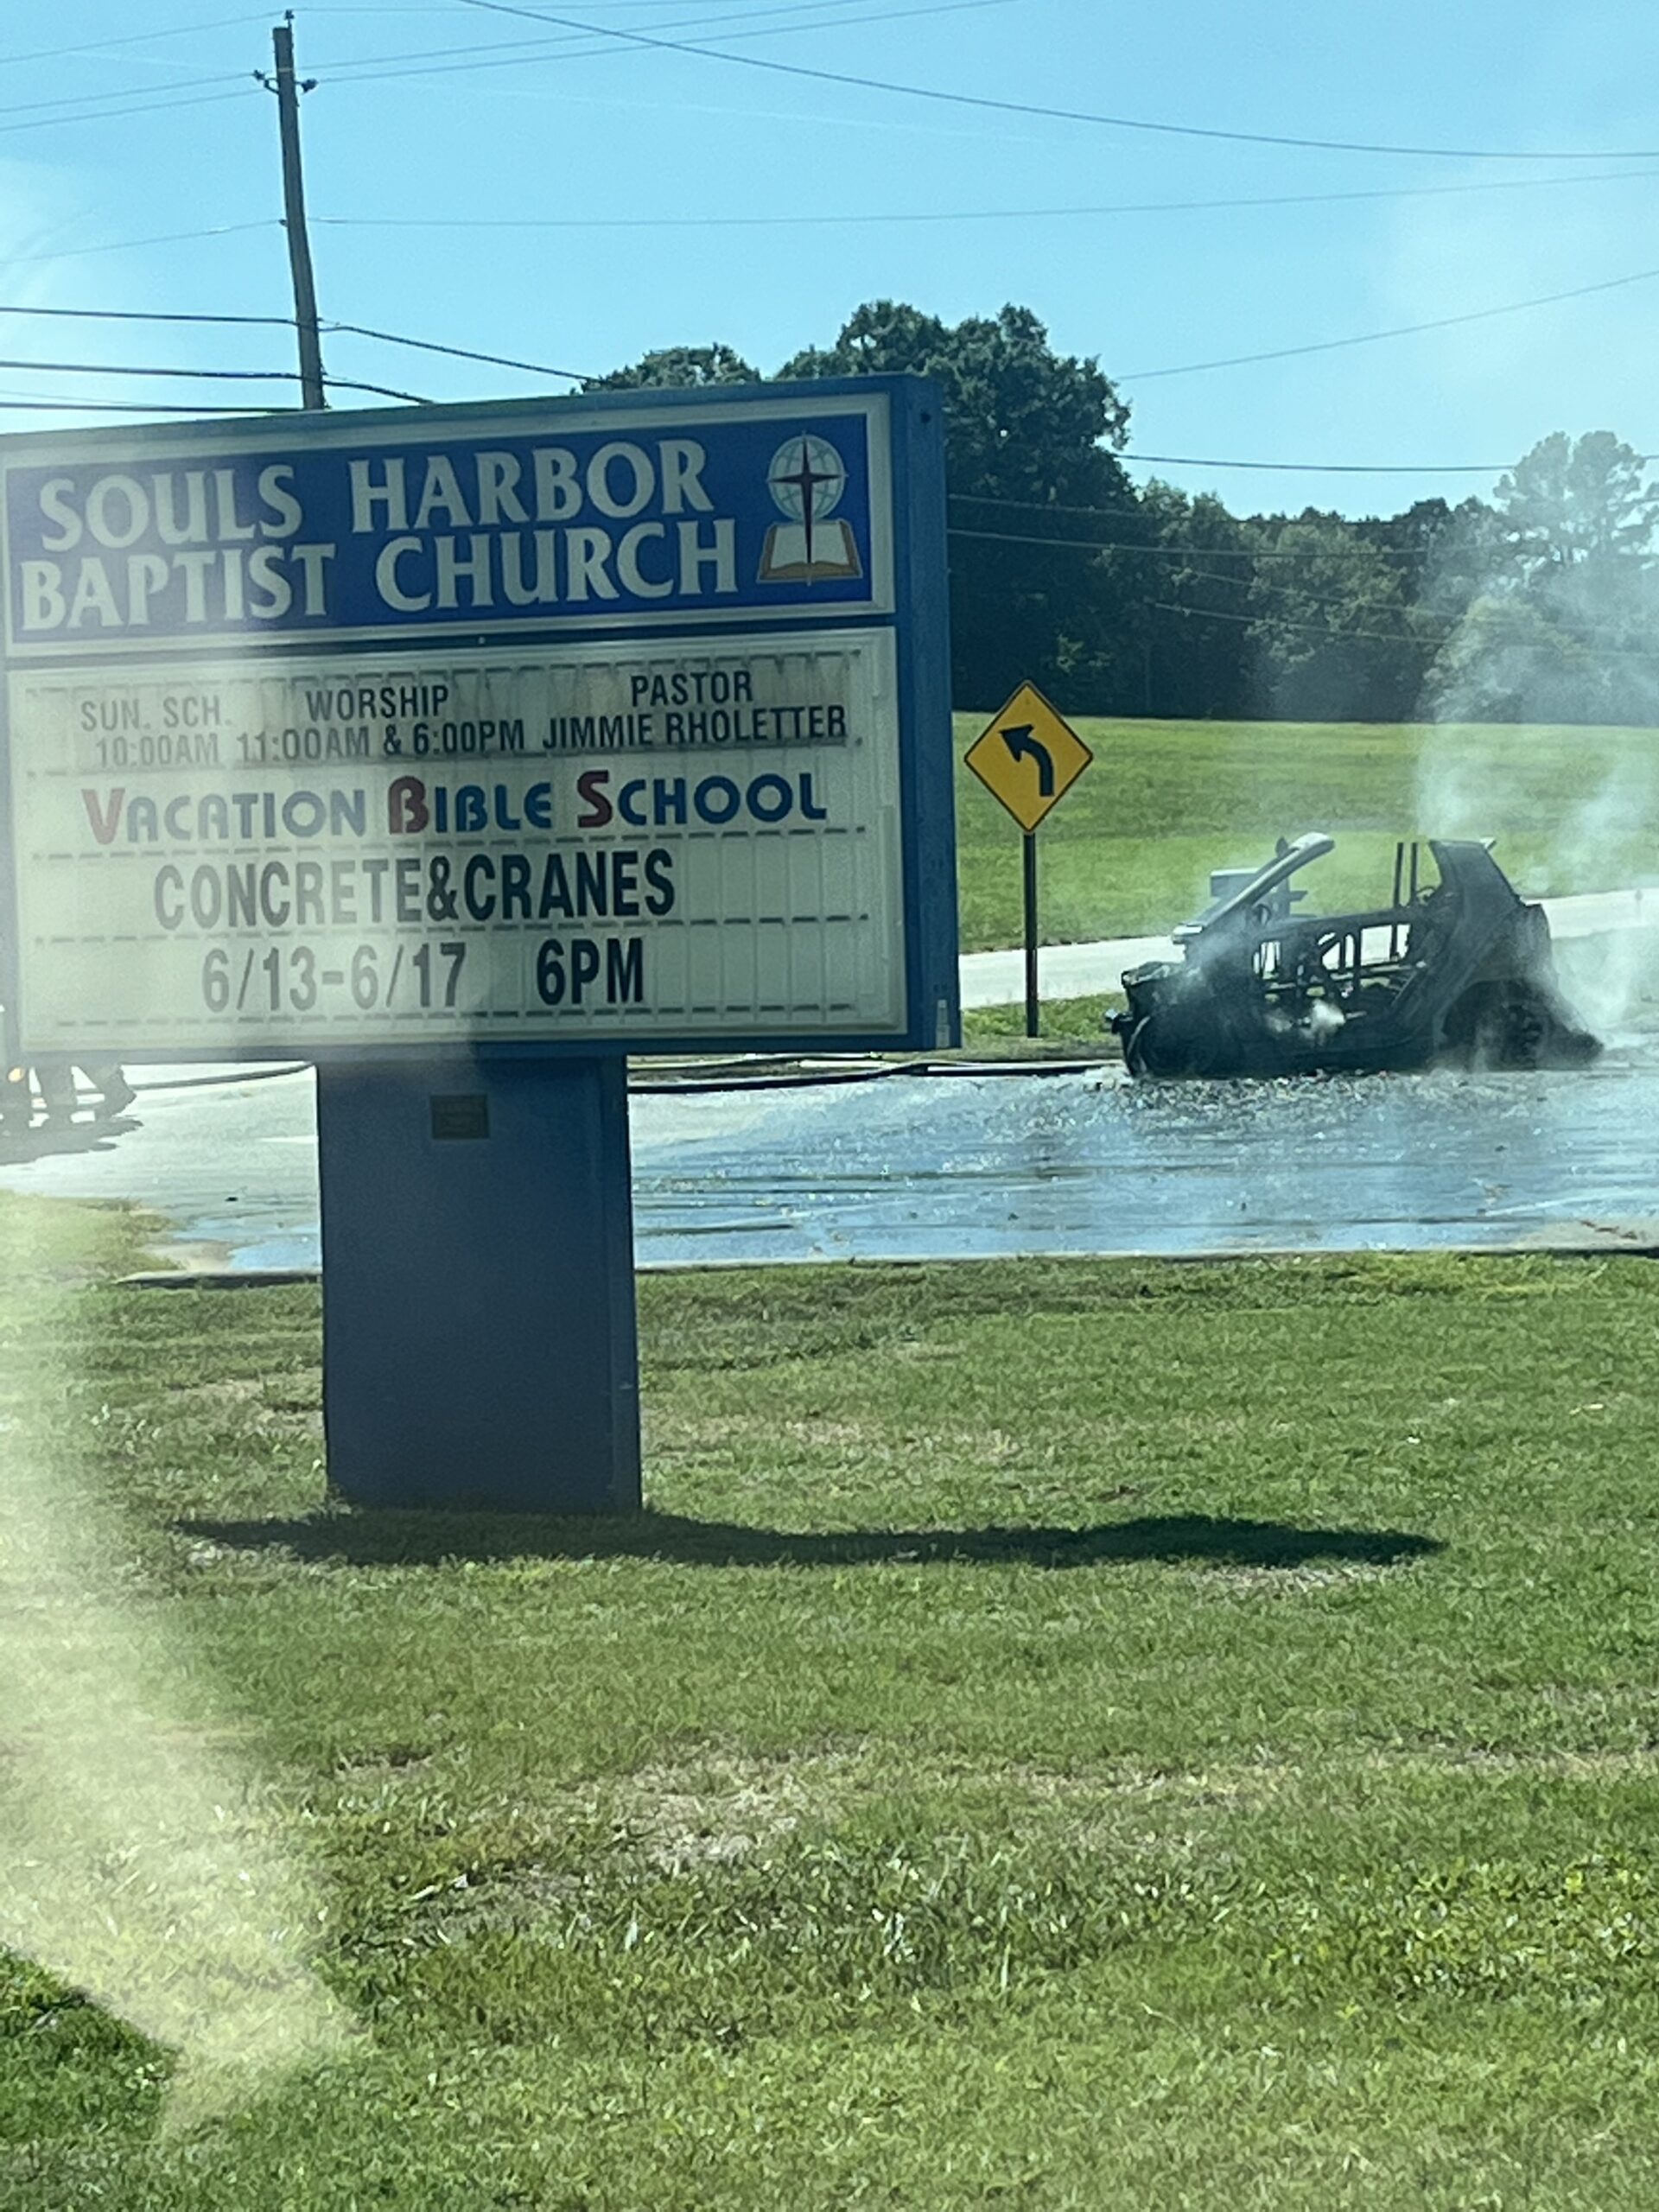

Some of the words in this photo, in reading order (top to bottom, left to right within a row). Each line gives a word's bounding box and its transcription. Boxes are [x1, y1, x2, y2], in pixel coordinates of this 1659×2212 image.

[39, 464, 303, 552] SOULS
[348, 439, 714, 533] HARBOR
[20, 543, 336, 631] BAPTIST
[376, 518, 739, 612] CHURCH
[305, 684, 448, 721] WORSHIP
[631, 671, 753, 707] PASTOR
[81, 699, 151, 731] SUN.
[163, 695, 232, 728] SCH.
[543, 713, 653, 750] JIMMIE
[666, 705, 847, 745] RHOLETTER
[95, 733, 219, 766] 10:00AM
[238, 728, 371, 762] 11:00AM
[383, 725, 402, 755] &
[413, 719, 525, 754] 6:00PM
[81, 787, 366, 845] VACATION
[387, 775, 553, 835] BIBLE
[576, 770, 827, 829] SCHOOL
[154, 849, 676, 930] CONCRETE&CRANES
[202, 942, 467, 1013] 6/13-6/17
[537, 938, 645, 1006] 6PM
